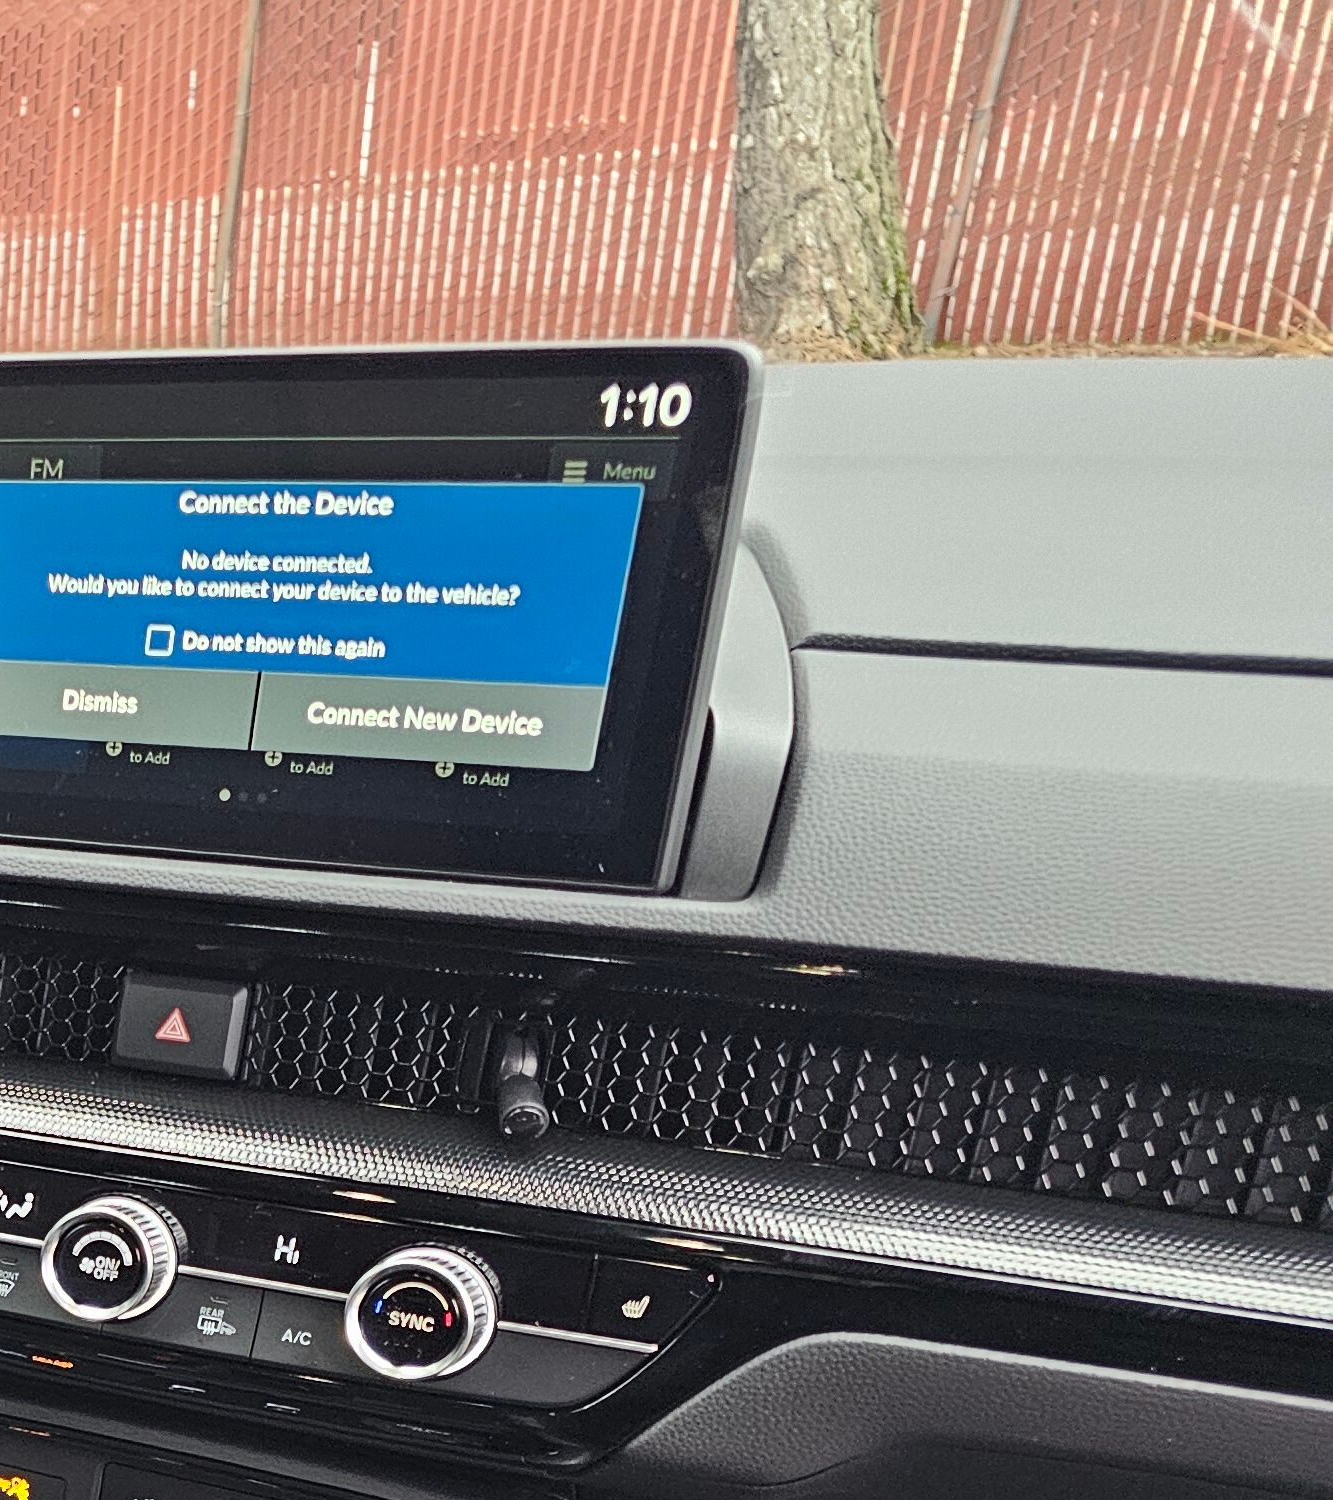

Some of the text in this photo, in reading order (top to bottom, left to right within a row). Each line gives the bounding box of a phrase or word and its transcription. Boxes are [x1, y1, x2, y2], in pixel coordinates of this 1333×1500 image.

[600, 381, 693, 428] 1:10
[30, 458, 64, 480] FM
[603, 461, 657, 480] Menu
[179, 489, 395, 517] Connect the Device
[181, 549, 373, 575] No device connected.
[48, 573, 521, 607] Would you like to connect your device to the vehicle?
[182, 629, 386, 661] Do not show this again
[61, 688, 139, 715] Dismiss
[306, 700, 544, 738] Connect New Device
[129, 751, 171, 766] to Add
[289, 760, 334, 776] to Add
[462, 770, 511, 788] to Add
[93, 1269, 119, 1282] OFF
[199, 1306, 225, 1318] REAR
[388, 1309, 435, 1333] SYNC
[281, 1328, 312, 1347] A/C
